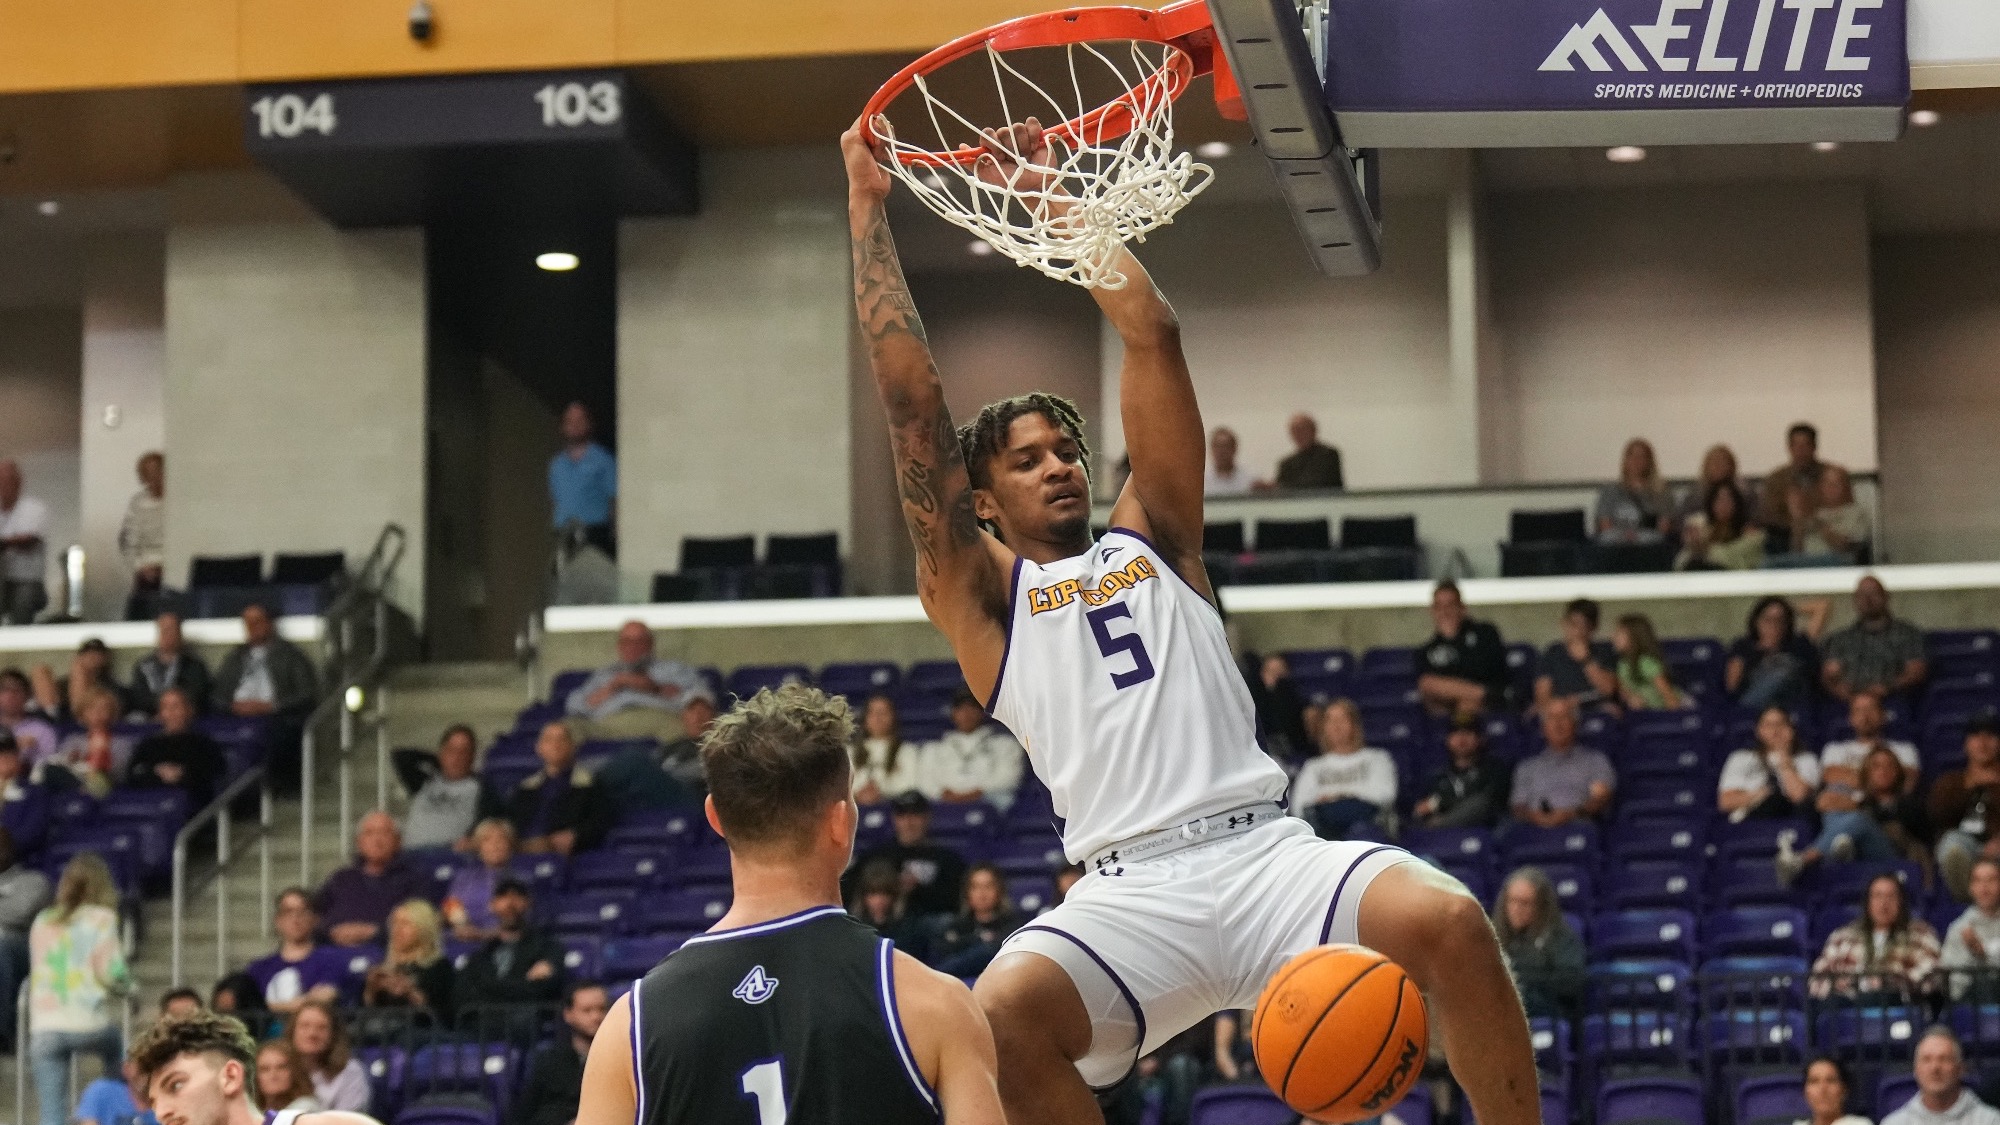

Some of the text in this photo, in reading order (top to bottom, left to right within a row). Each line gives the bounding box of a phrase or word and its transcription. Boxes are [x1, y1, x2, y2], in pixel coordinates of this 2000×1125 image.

[1630, 0, 1883, 72] ELITE
[252, 93, 336, 138] 104
[534, 81, 621, 126] 103
[1594, 84, 1655, 99] SPORTS
[1658, 83, 1738, 99] MEDICINE
[1753, 83, 1863, 99] ORTHOPEDICS
[1086, 600, 1156, 691] 5
[739, 1059, 787, 1125] 1
